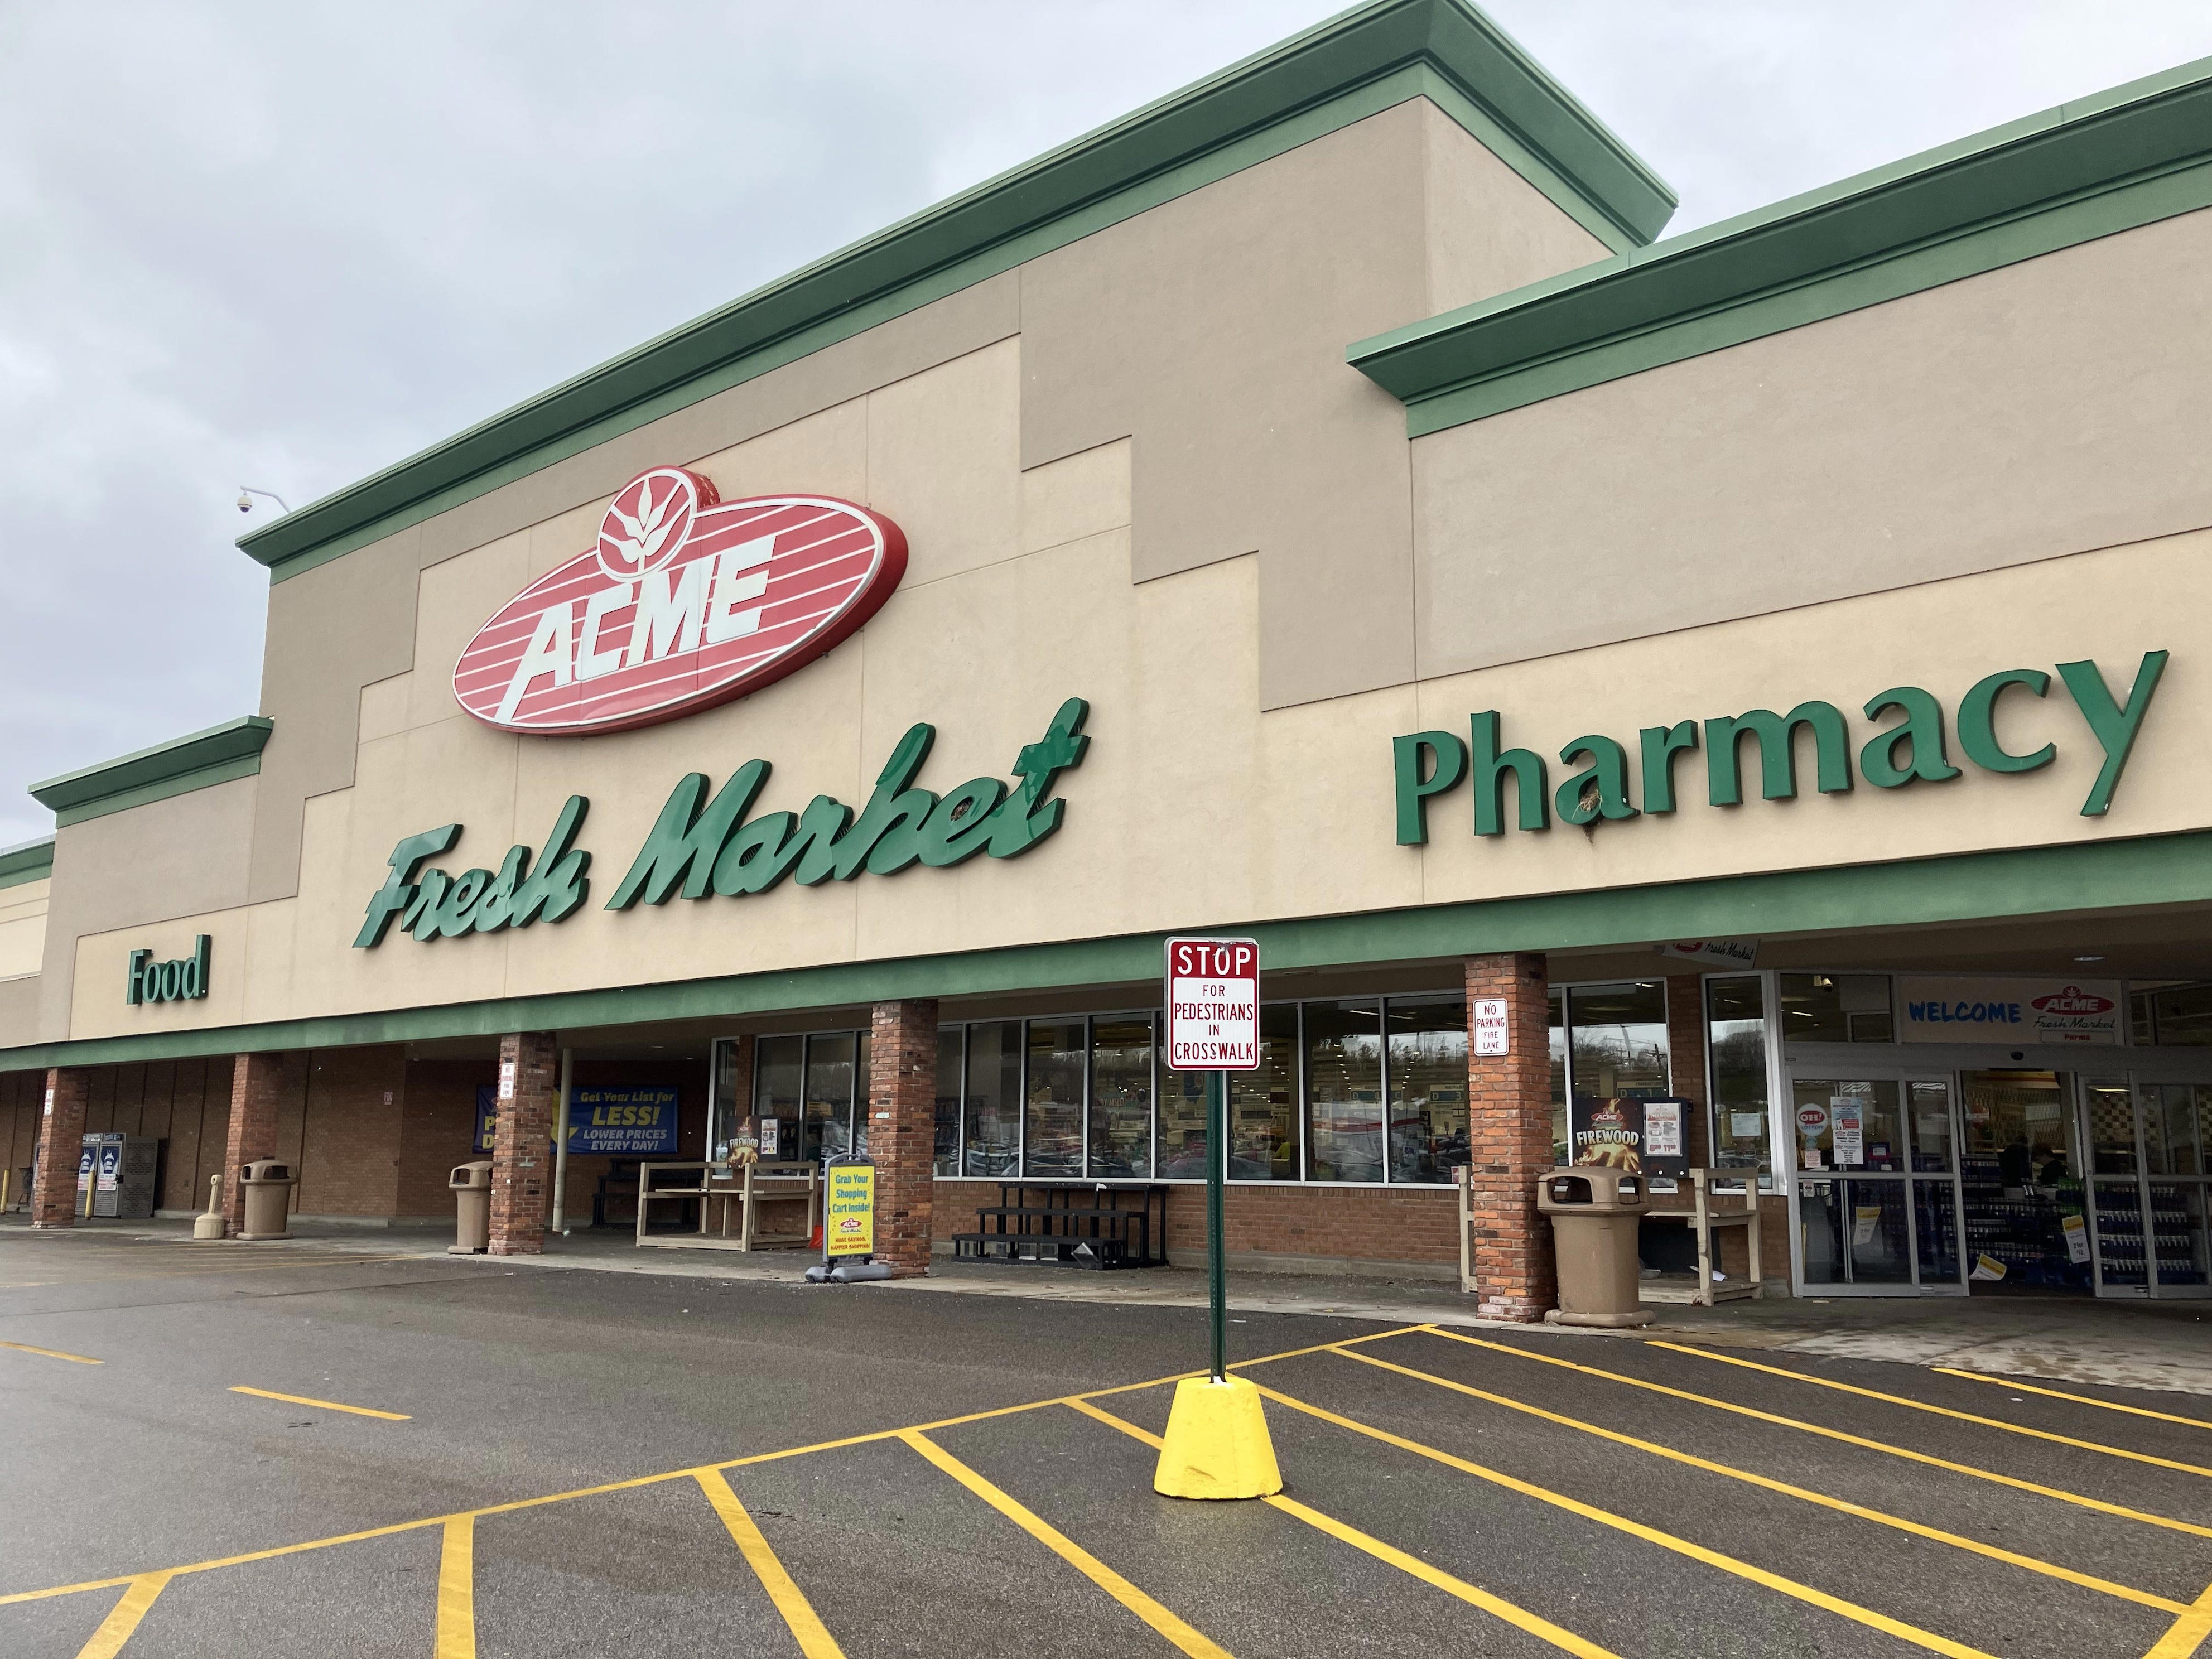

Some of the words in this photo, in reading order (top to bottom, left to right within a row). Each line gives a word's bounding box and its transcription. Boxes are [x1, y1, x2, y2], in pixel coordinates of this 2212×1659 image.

[494, 534, 777, 725] ACME
[1392, 648, 2169, 846] Pharmacy
[352, 794, 591, 949] Fresh
[604, 697, 1091, 912] Market
[1726, 942, 1755, 961] Market
[1177, 945, 1251, 976] STOP
[126, 934, 211, 1005] Food
[1203, 985, 1225, 997] FOR
[1174, 1002, 1254, 1021] PEDESTRIANS
[1485, 1005, 1496, 1015] NO
[1908, 1001, 2023, 1024] WELCOME
[2042, 999, 2099, 1012] ACME
[1477, 1017, 1505, 1028] PARKING
[2033, 1015, 2067, 1028] Fresh
[2069, 1017, 2115, 1029] Market
[1208, 1024, 1220, 1036] IN
[1174, 1042, 1254, 1060] CROSSWALK
[580, 1092, 600, 1102] Get
[603, 1092, 630, 1102] Your
[632, 1091, 654, 1102] List
[654, 1092, 674, 1105] for
[591, 1106, 661, 1126] LESS!
[1800, 1112, 1823, 1121] OH!
[583, 1129, 624, 1139] LOWER
[625, 1129, 667, 1139] PRICES
[1576, 1128, 1640, 1146] FIREWOOD
[591, 1141, 630, 1151] EVERY
[632, 1140, 658, 1151] DAY!
[729, 1137, 759, 1149] FIREWOOD
[836, 1174, 852, 1184] Grab
[853, 1174, 868, 1184] Your
[836, 1188, 868, 1200] Shopping
[832, 1203, 847, 1213] Cart
[848, 1202, 870, 1213] Inside!
